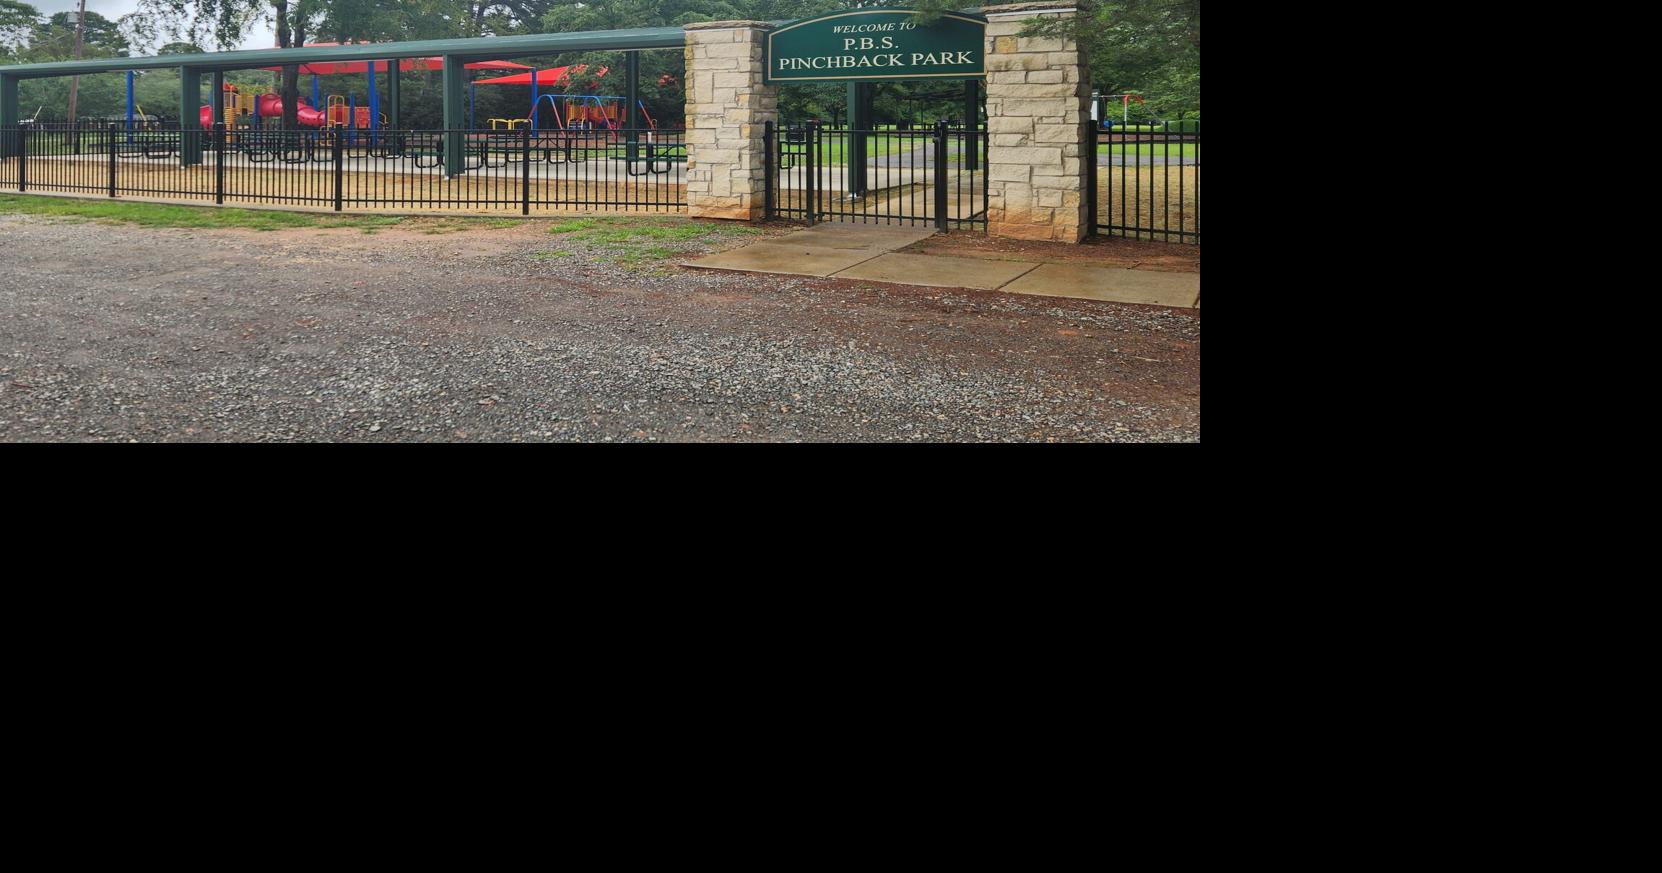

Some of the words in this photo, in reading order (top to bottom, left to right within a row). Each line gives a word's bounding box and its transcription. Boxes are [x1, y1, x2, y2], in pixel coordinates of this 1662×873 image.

[833, 23, 895, 33] WELCOME
[899, 22, 917, 31] TO
[844, 36, 899, 50] P.B.S.
[779, 53, 906, 70] PINCHBACK
[911, 51, 975, 66] PARK
